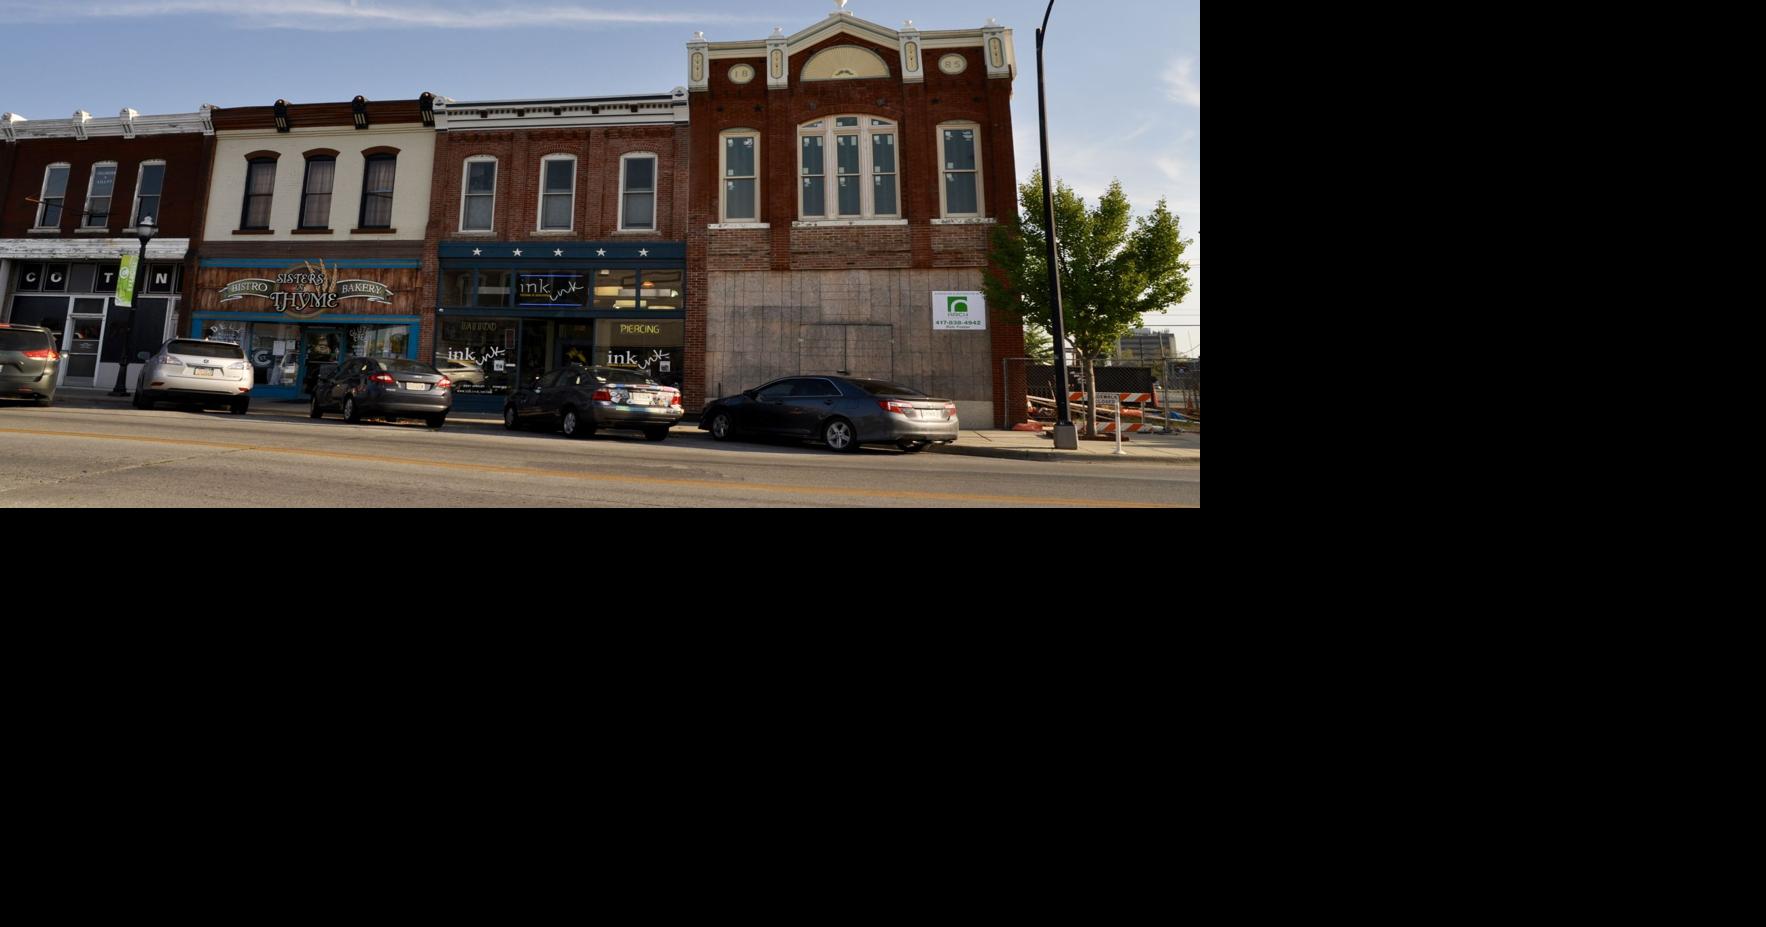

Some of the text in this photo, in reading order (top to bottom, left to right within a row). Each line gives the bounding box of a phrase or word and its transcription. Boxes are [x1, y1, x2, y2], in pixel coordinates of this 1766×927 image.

[276, 273, 324, 286] SISTERS
[520, 279, 550, 293] ink
[231, 282, 268, 292] BISTRO
[341, 283, 383, 294] BAKERY
[270, 291, 338, 312] THYME
[620, 324, 660, 334] PIERCING
[448, 347, 476, 361] ink
[608, 350, 639, 365] ink
